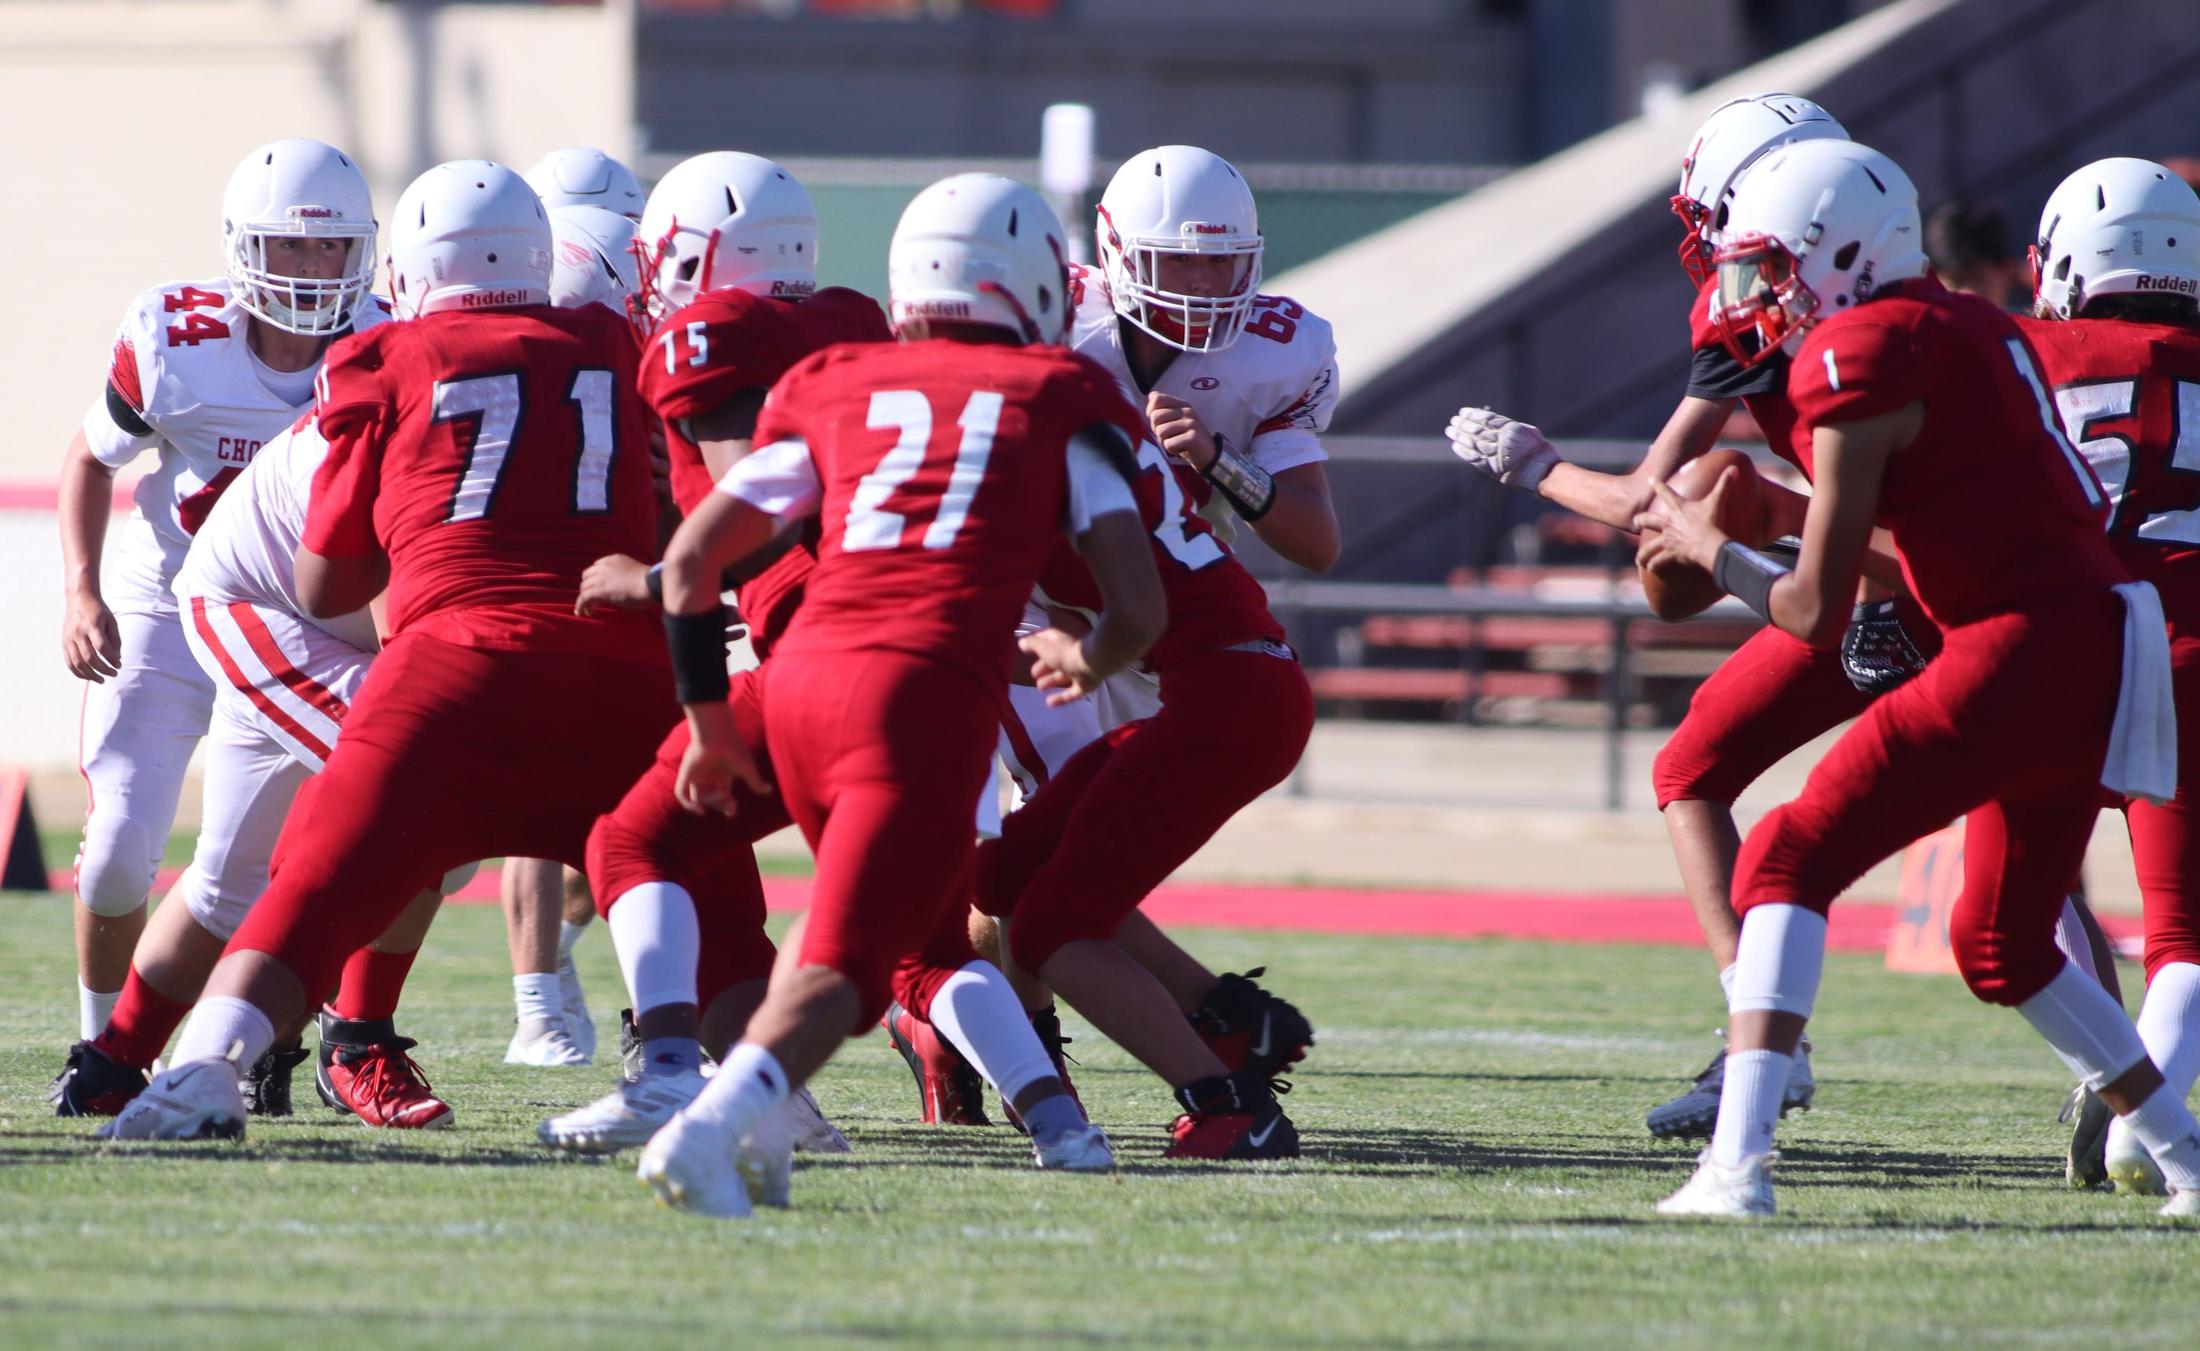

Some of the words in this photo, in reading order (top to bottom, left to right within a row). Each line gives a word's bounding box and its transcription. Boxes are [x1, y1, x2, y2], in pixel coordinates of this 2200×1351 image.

[300, 208, 332, 218] Riddell
[1196, 224, 1227, 234] Riddell
[461, 289, 528, 306] Riddell
[770, 280, 817, 295] Riddel
[2136, 274, 2198, 294] Riddell
[163, 286, 231, 347] 44
[1822, 348, 1841, 392] 1
[2004, 336, 2104, 508] 1
[217, 436, 270, 463] CHO
[432, 368, 618, 524] 71
[842, 389, 1004, 552] 21
